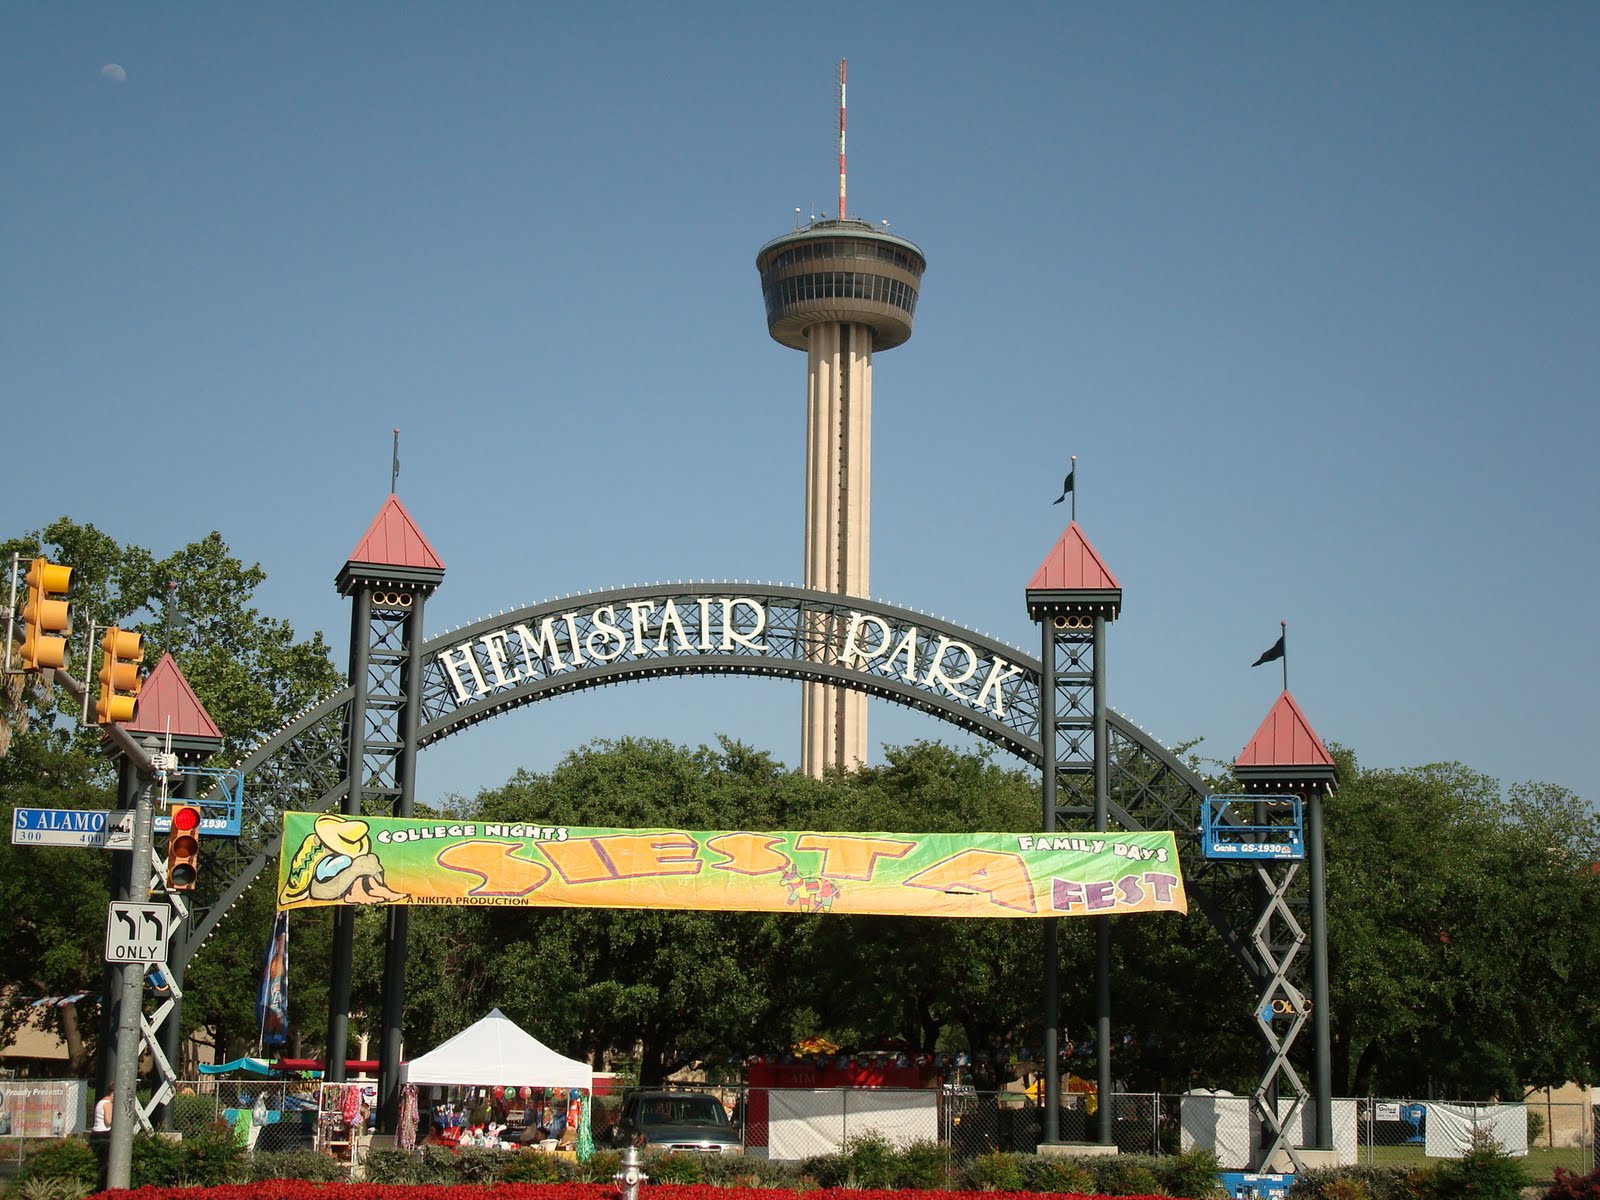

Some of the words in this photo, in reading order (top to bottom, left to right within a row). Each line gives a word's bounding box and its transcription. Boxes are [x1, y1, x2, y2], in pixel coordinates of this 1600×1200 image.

[438, 597, 769, 704] HEMISFAIR
[837, 610, 1025, 717] PARK
[17, 810, 29, 829] S
[36, 811, 104, 832] ALAMO
[19, 831, 42, 841] 300
[79, 834, 101, 843] 400
[377, 824, 477, 844] COLLEGE
[484, 823, 569, 842] NIGHTS
[1017, 836, 1105, 854] FAMILY
[1112, 842, 1169, 863] DAYS
[1213, 844, 1238, 852] Genie
[1241, 844, 1282, 853] GS-1930
[436, 831, 1038, 914] SIESTA
[407, 896, 414, 904] A
[416, 896, 453, 905] NIKITA
[456, 897, 529, 906] PRODUCTION
[1051, 872, 1179, 912] FEST
[115, 945, 158, 960] ONLY
[5, 1088, 32, 1098] Proudly
[33, 1088, 64, 1096] Presents
